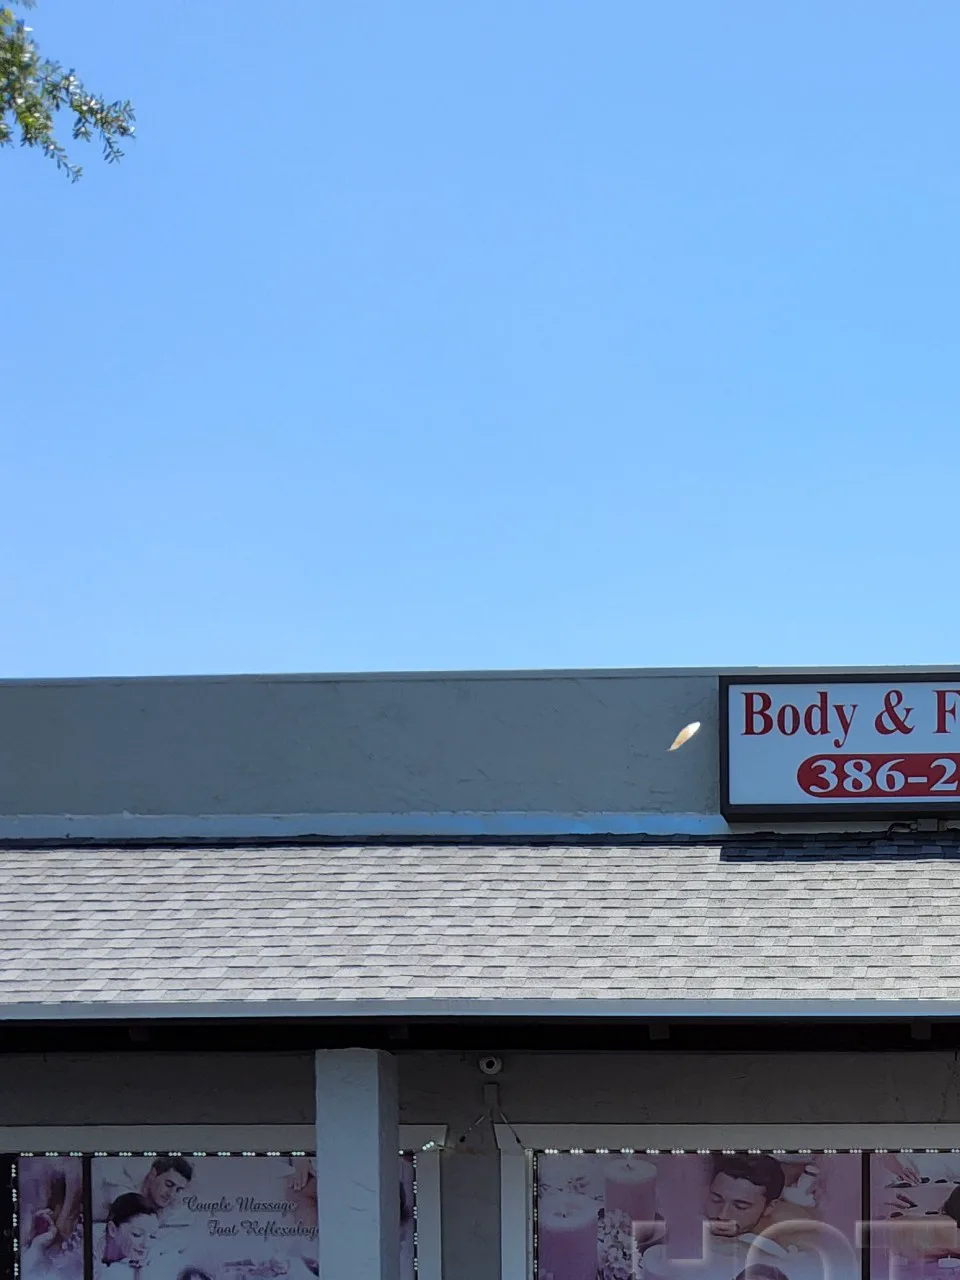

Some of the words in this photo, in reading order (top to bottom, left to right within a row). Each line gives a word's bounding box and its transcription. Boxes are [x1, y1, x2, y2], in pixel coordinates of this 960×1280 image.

[741, 690, 857, 748] Body
[874, 689, 915, 735] &
[183, 1195, 232, 1217] Couple
[236, 1196, 296, 1218] Massage
[208, 1219, 239, 1236] Foot
[240, 1220, 319, 1242] Reflexolog
